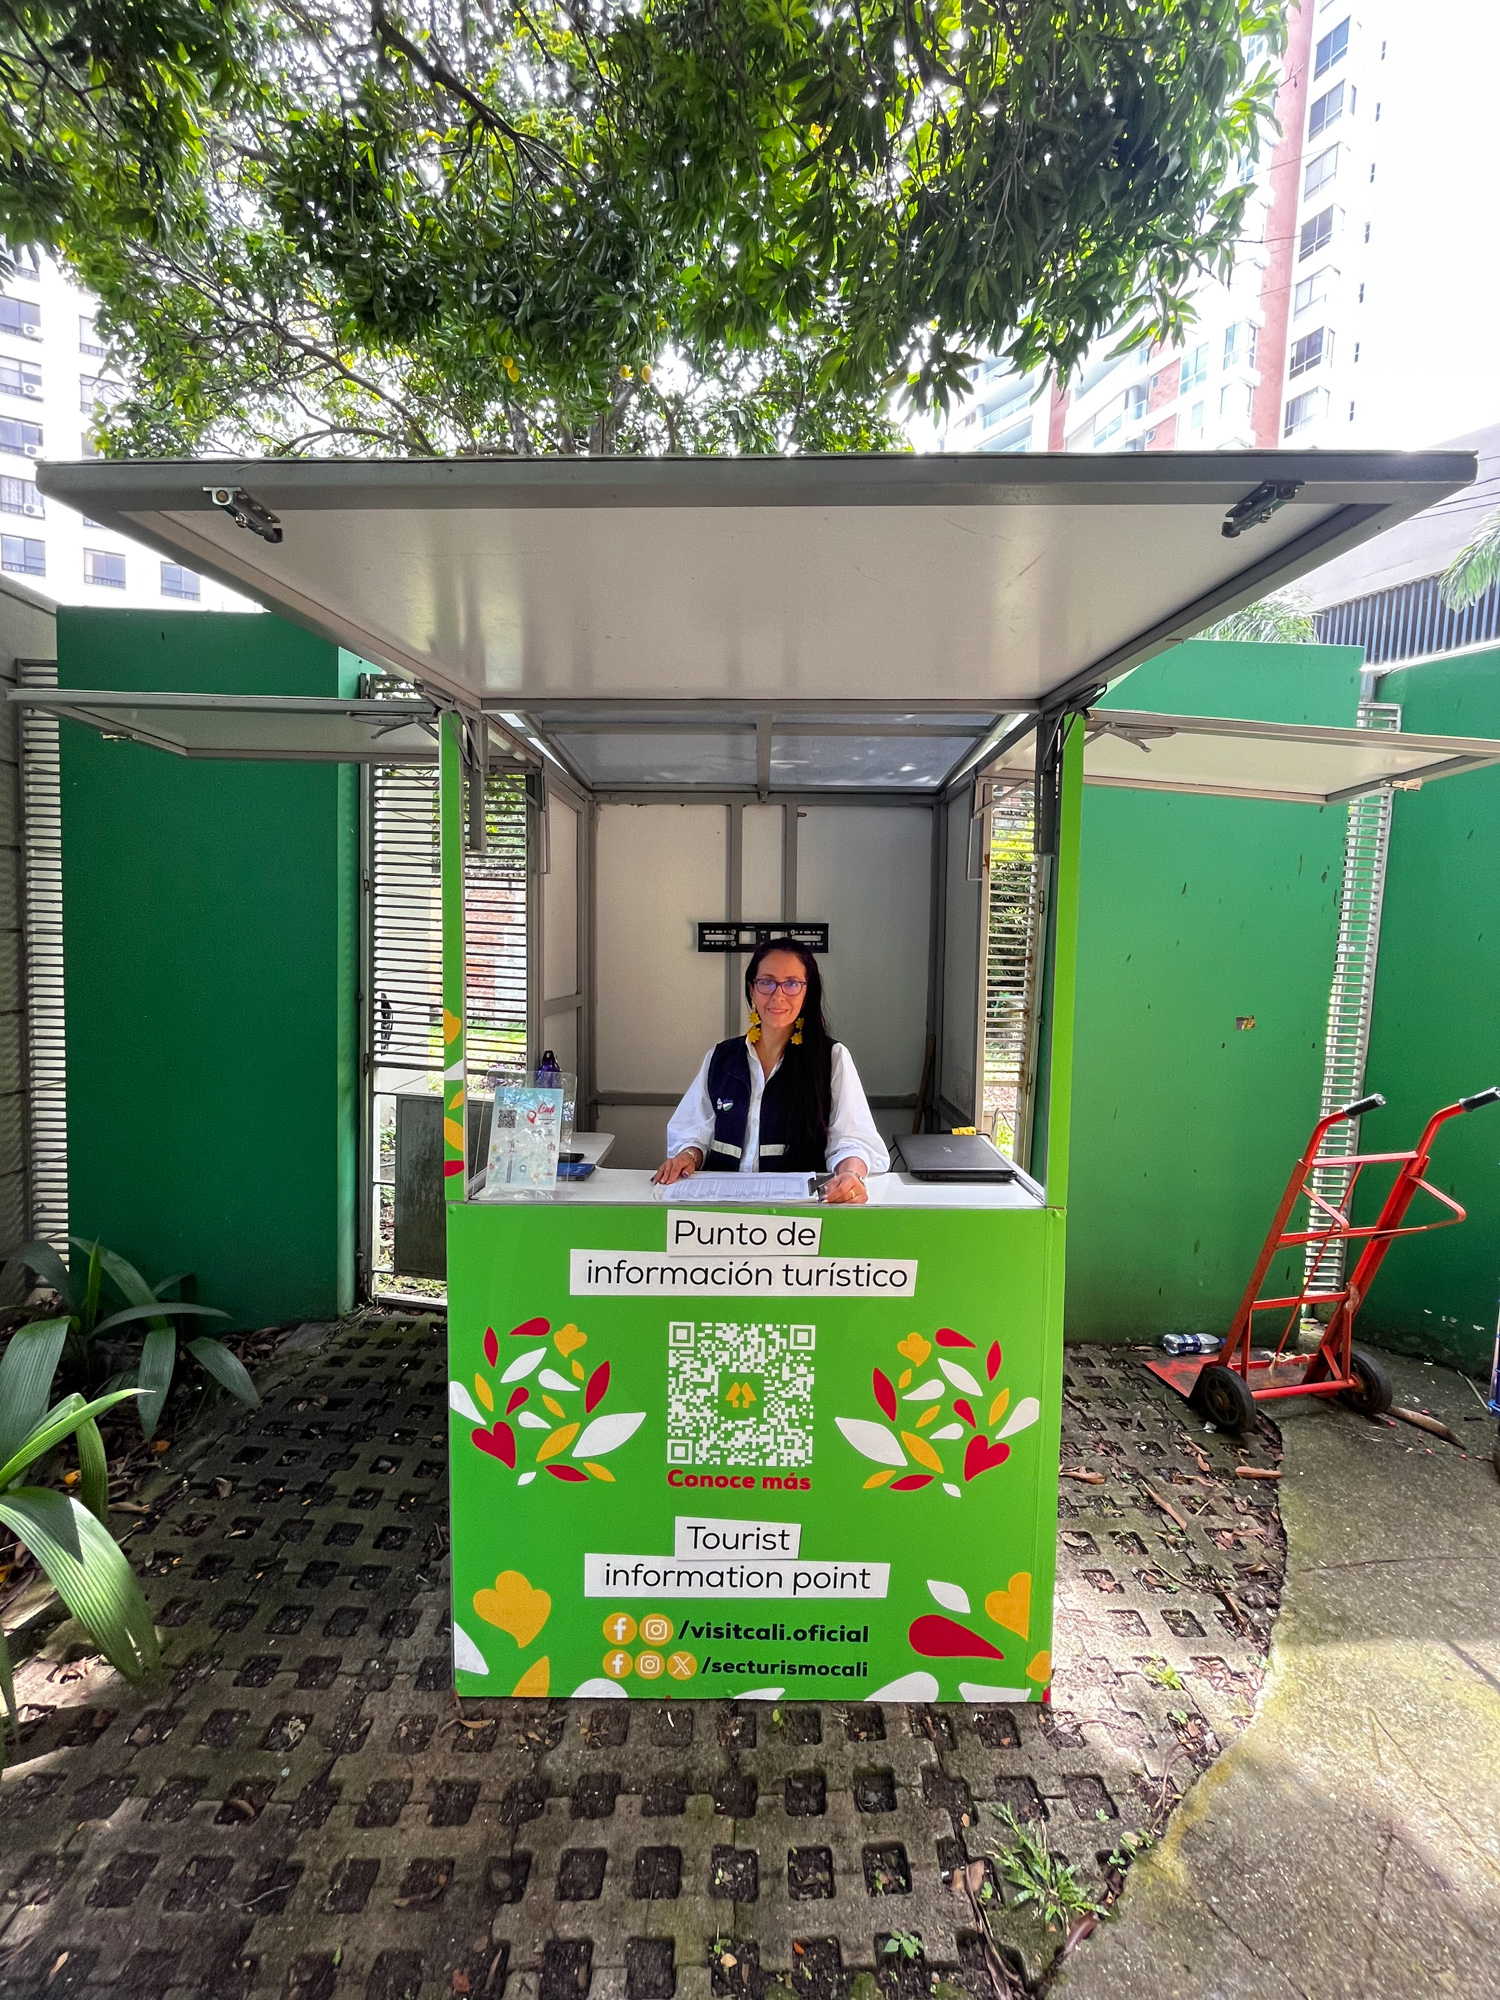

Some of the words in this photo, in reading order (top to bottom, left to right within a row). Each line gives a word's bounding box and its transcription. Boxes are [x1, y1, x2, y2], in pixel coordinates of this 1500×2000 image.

[675, 1219, 767, 1246] Punto
[776, 1220, 816, 1246] de
[587, 1259, 772, 1286] información
[781, 1262, 908, 1288] turístico
[668, 1470, 756, 1489] Conoce
[762, 1469, 811, 1491] más
[686, 1526, 790, 1551] Tourist
[605, 1562, 783, 1589] information
[793, 1568, 871, 1596] point
[677, 1619, 869, 1643] /visitcali.oficial
[700, 1656, 868, 1678] /secturismocali
